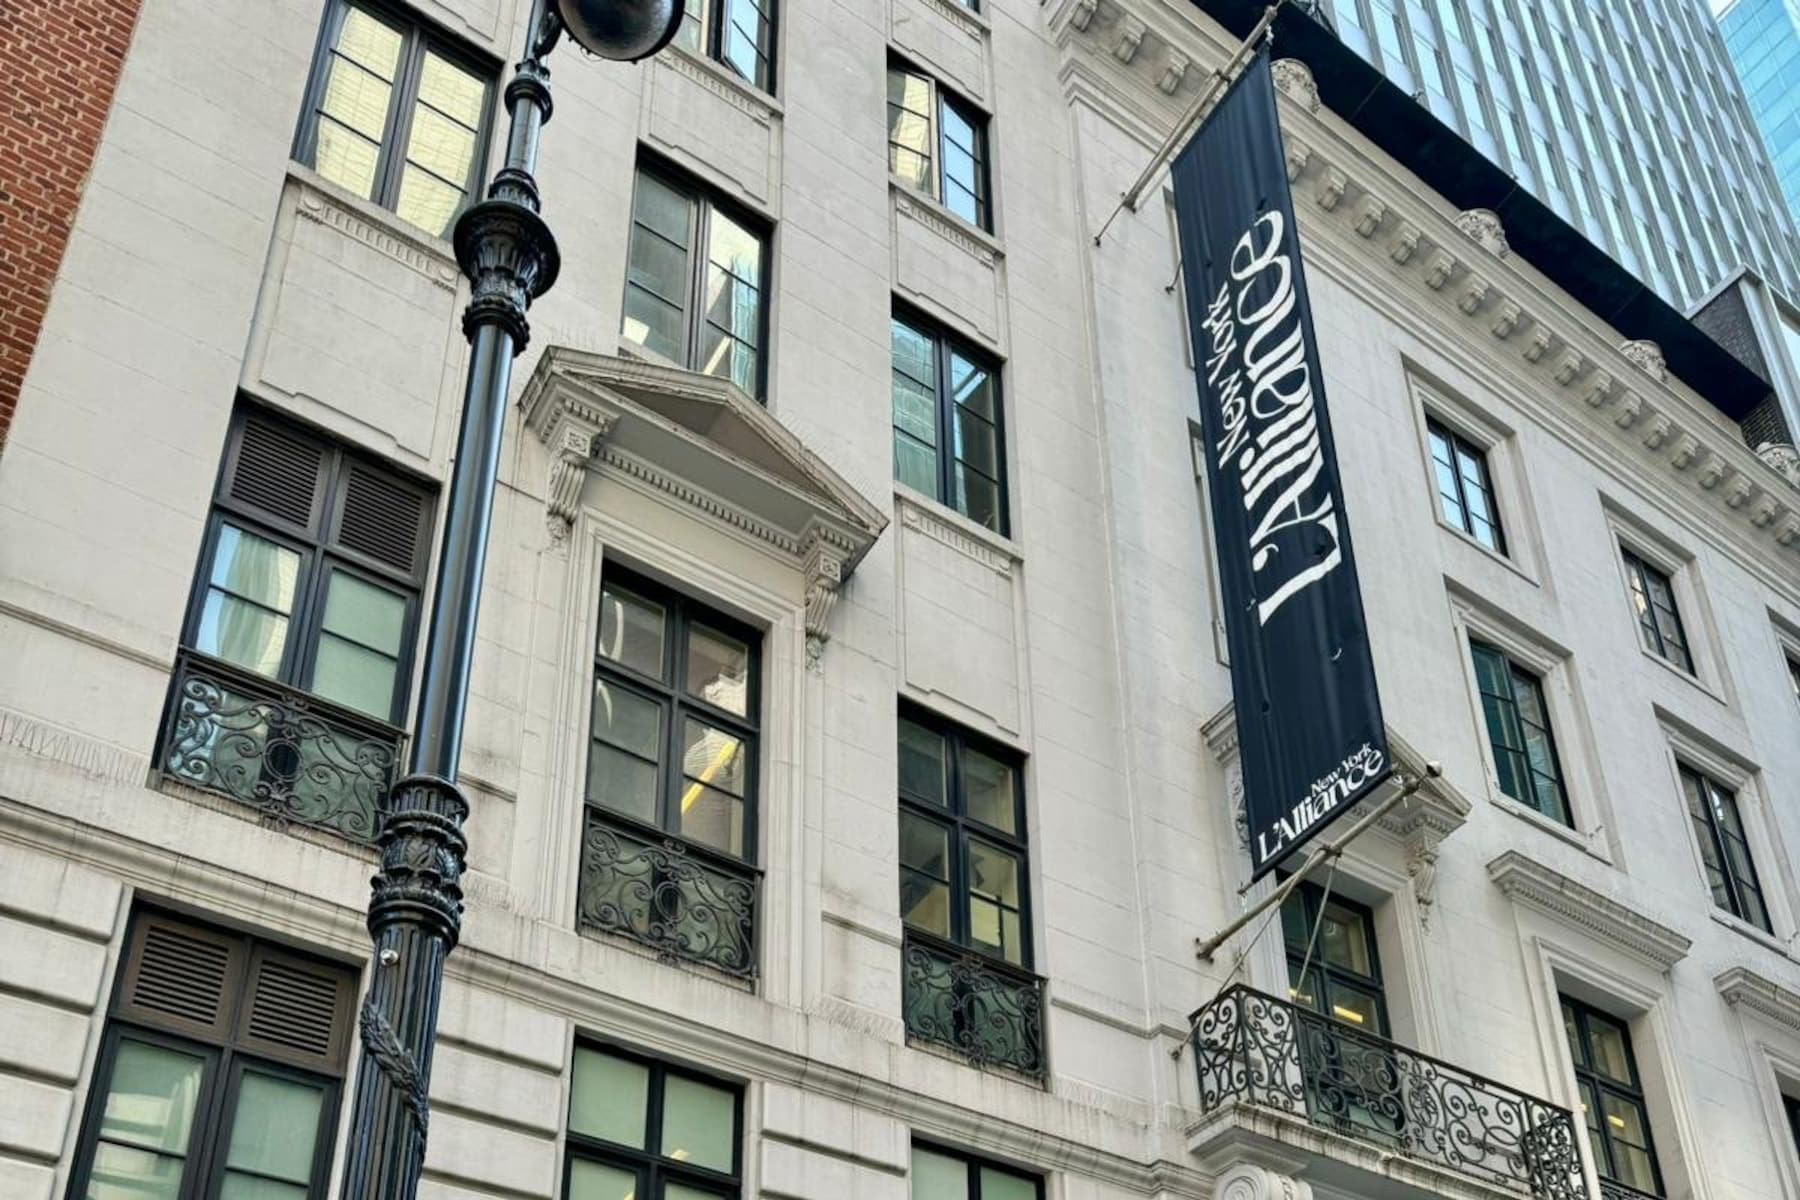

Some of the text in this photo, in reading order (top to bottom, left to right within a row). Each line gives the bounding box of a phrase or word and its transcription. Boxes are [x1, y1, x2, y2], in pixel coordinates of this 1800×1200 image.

[1201, 280, 1251, 469] New York
[1230, 210, 1342, 627] L'Alliance
[1258, 749, 1384, 863] L'Alliance
[1311, 742, 1373, 798] New York
